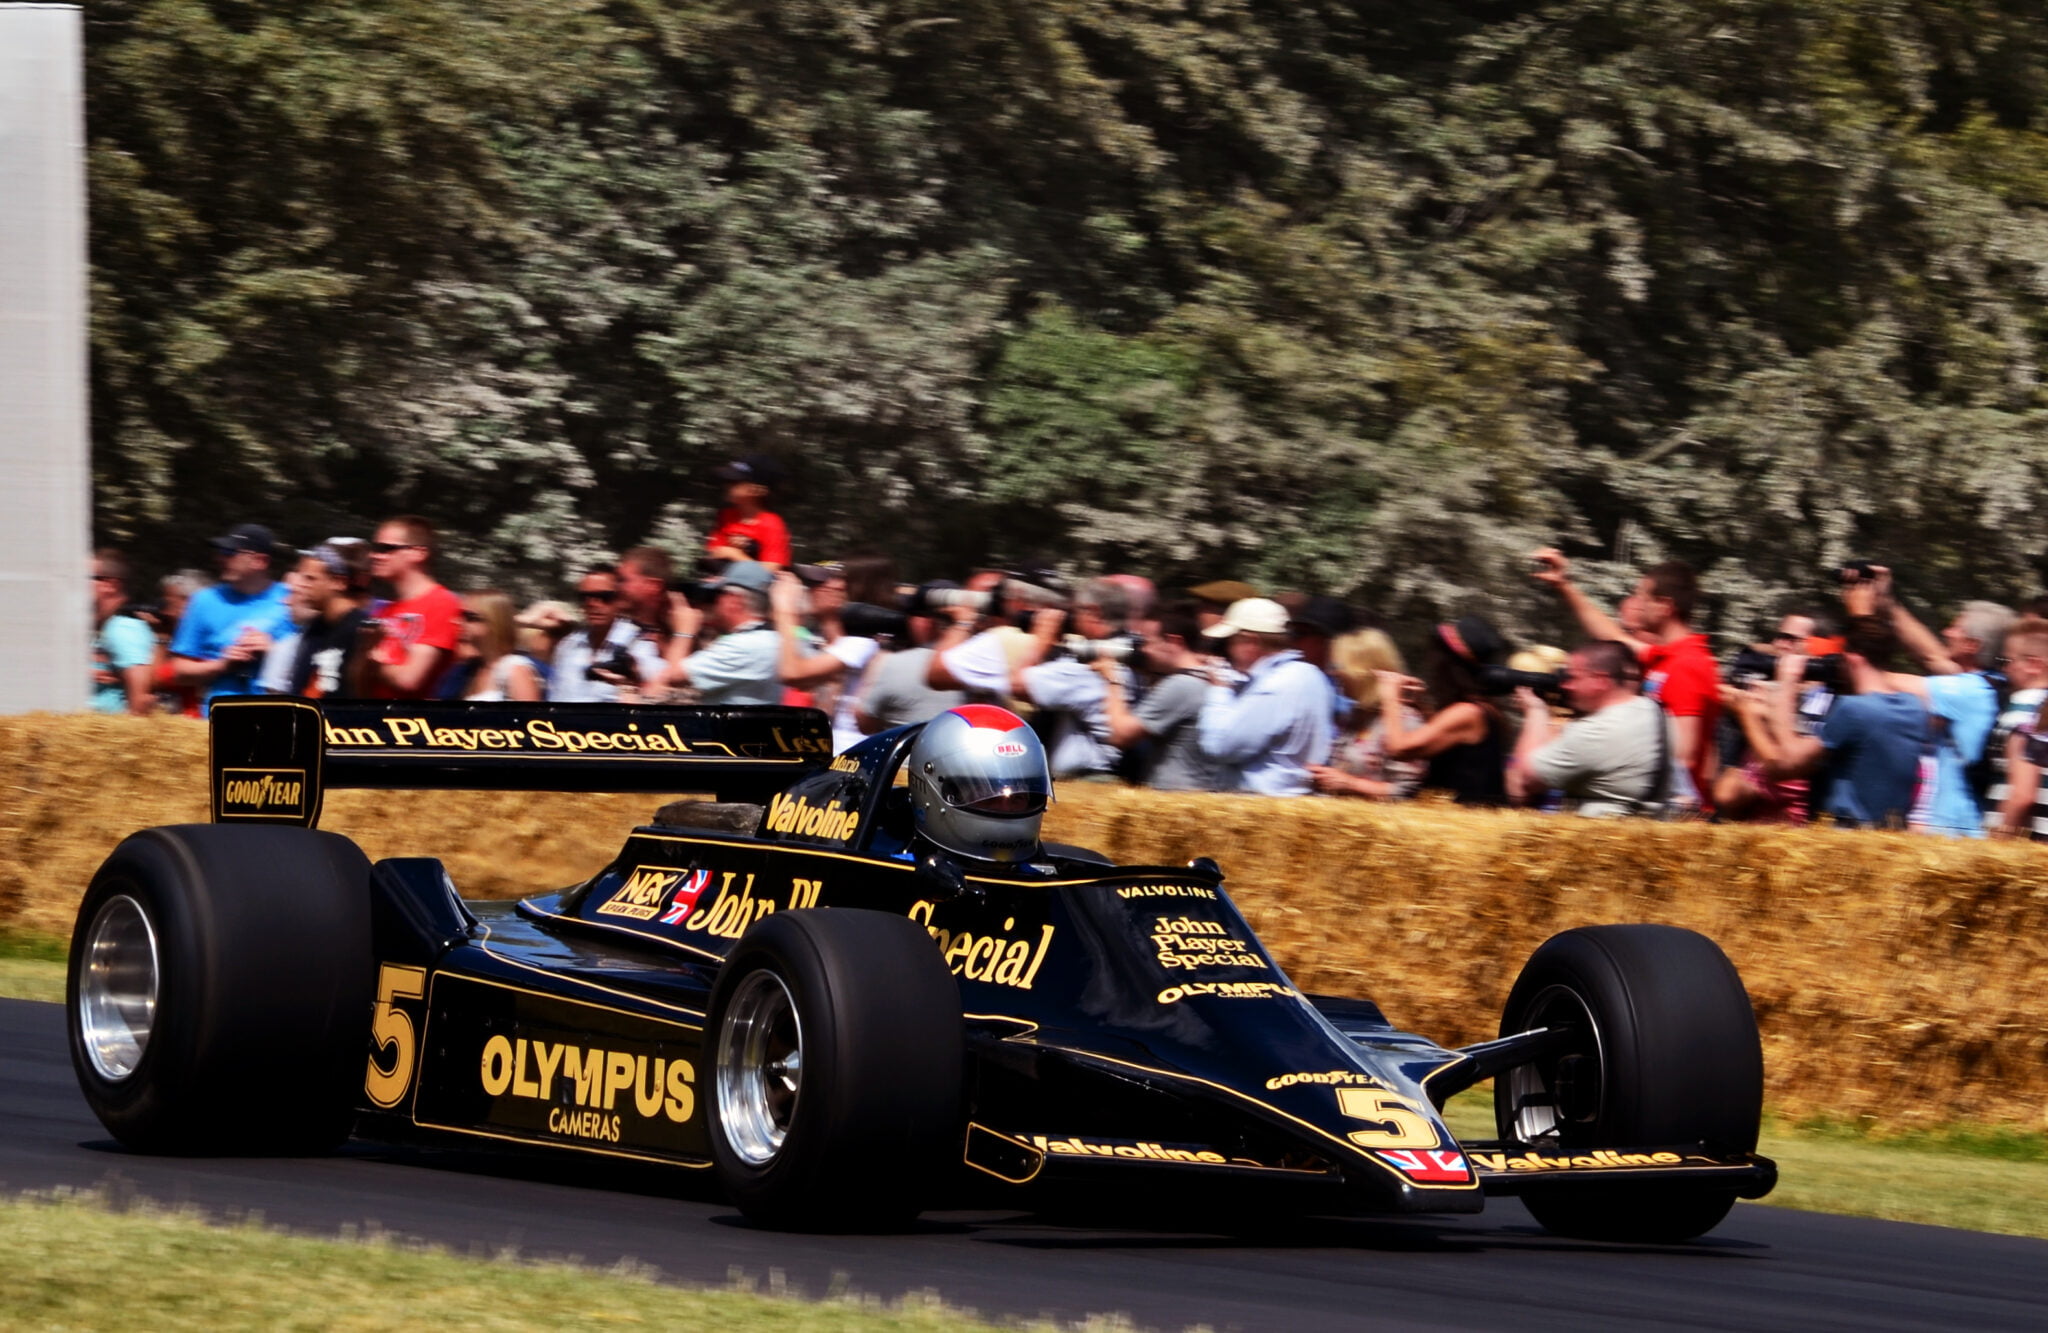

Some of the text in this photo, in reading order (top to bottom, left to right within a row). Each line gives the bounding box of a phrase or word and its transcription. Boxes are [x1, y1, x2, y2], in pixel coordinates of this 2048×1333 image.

[325, 718, 693, 752] hn Player Special
[997, 744, 1024, 753] BELL
[829, 755, 860, 774] Mario
[226, 775, 301, 809] GOODYEAR
[766, 792, 860, 841] Valvoline
[614, 871, 679, 905] NGK
[1116, 884, 1218, 901] VALVOLINE
[686, 872, 775, 939] John
[1154, 917, 1227, 936] John
[1151, 934, 1247, 955] Player
[1157, 951, 1269, 971] Special
[1157, 982, 1312, 1005] OLYMPU
[364, 960, 428, 1109] 5
[481, 1034, 696, 1123] OLYMPUS
[549, 1107, 621, 1143] CAMERAS
[1335, 1087, 1441, 1149] 5
[1468, 1149, 1683, 1172] Valvoline
